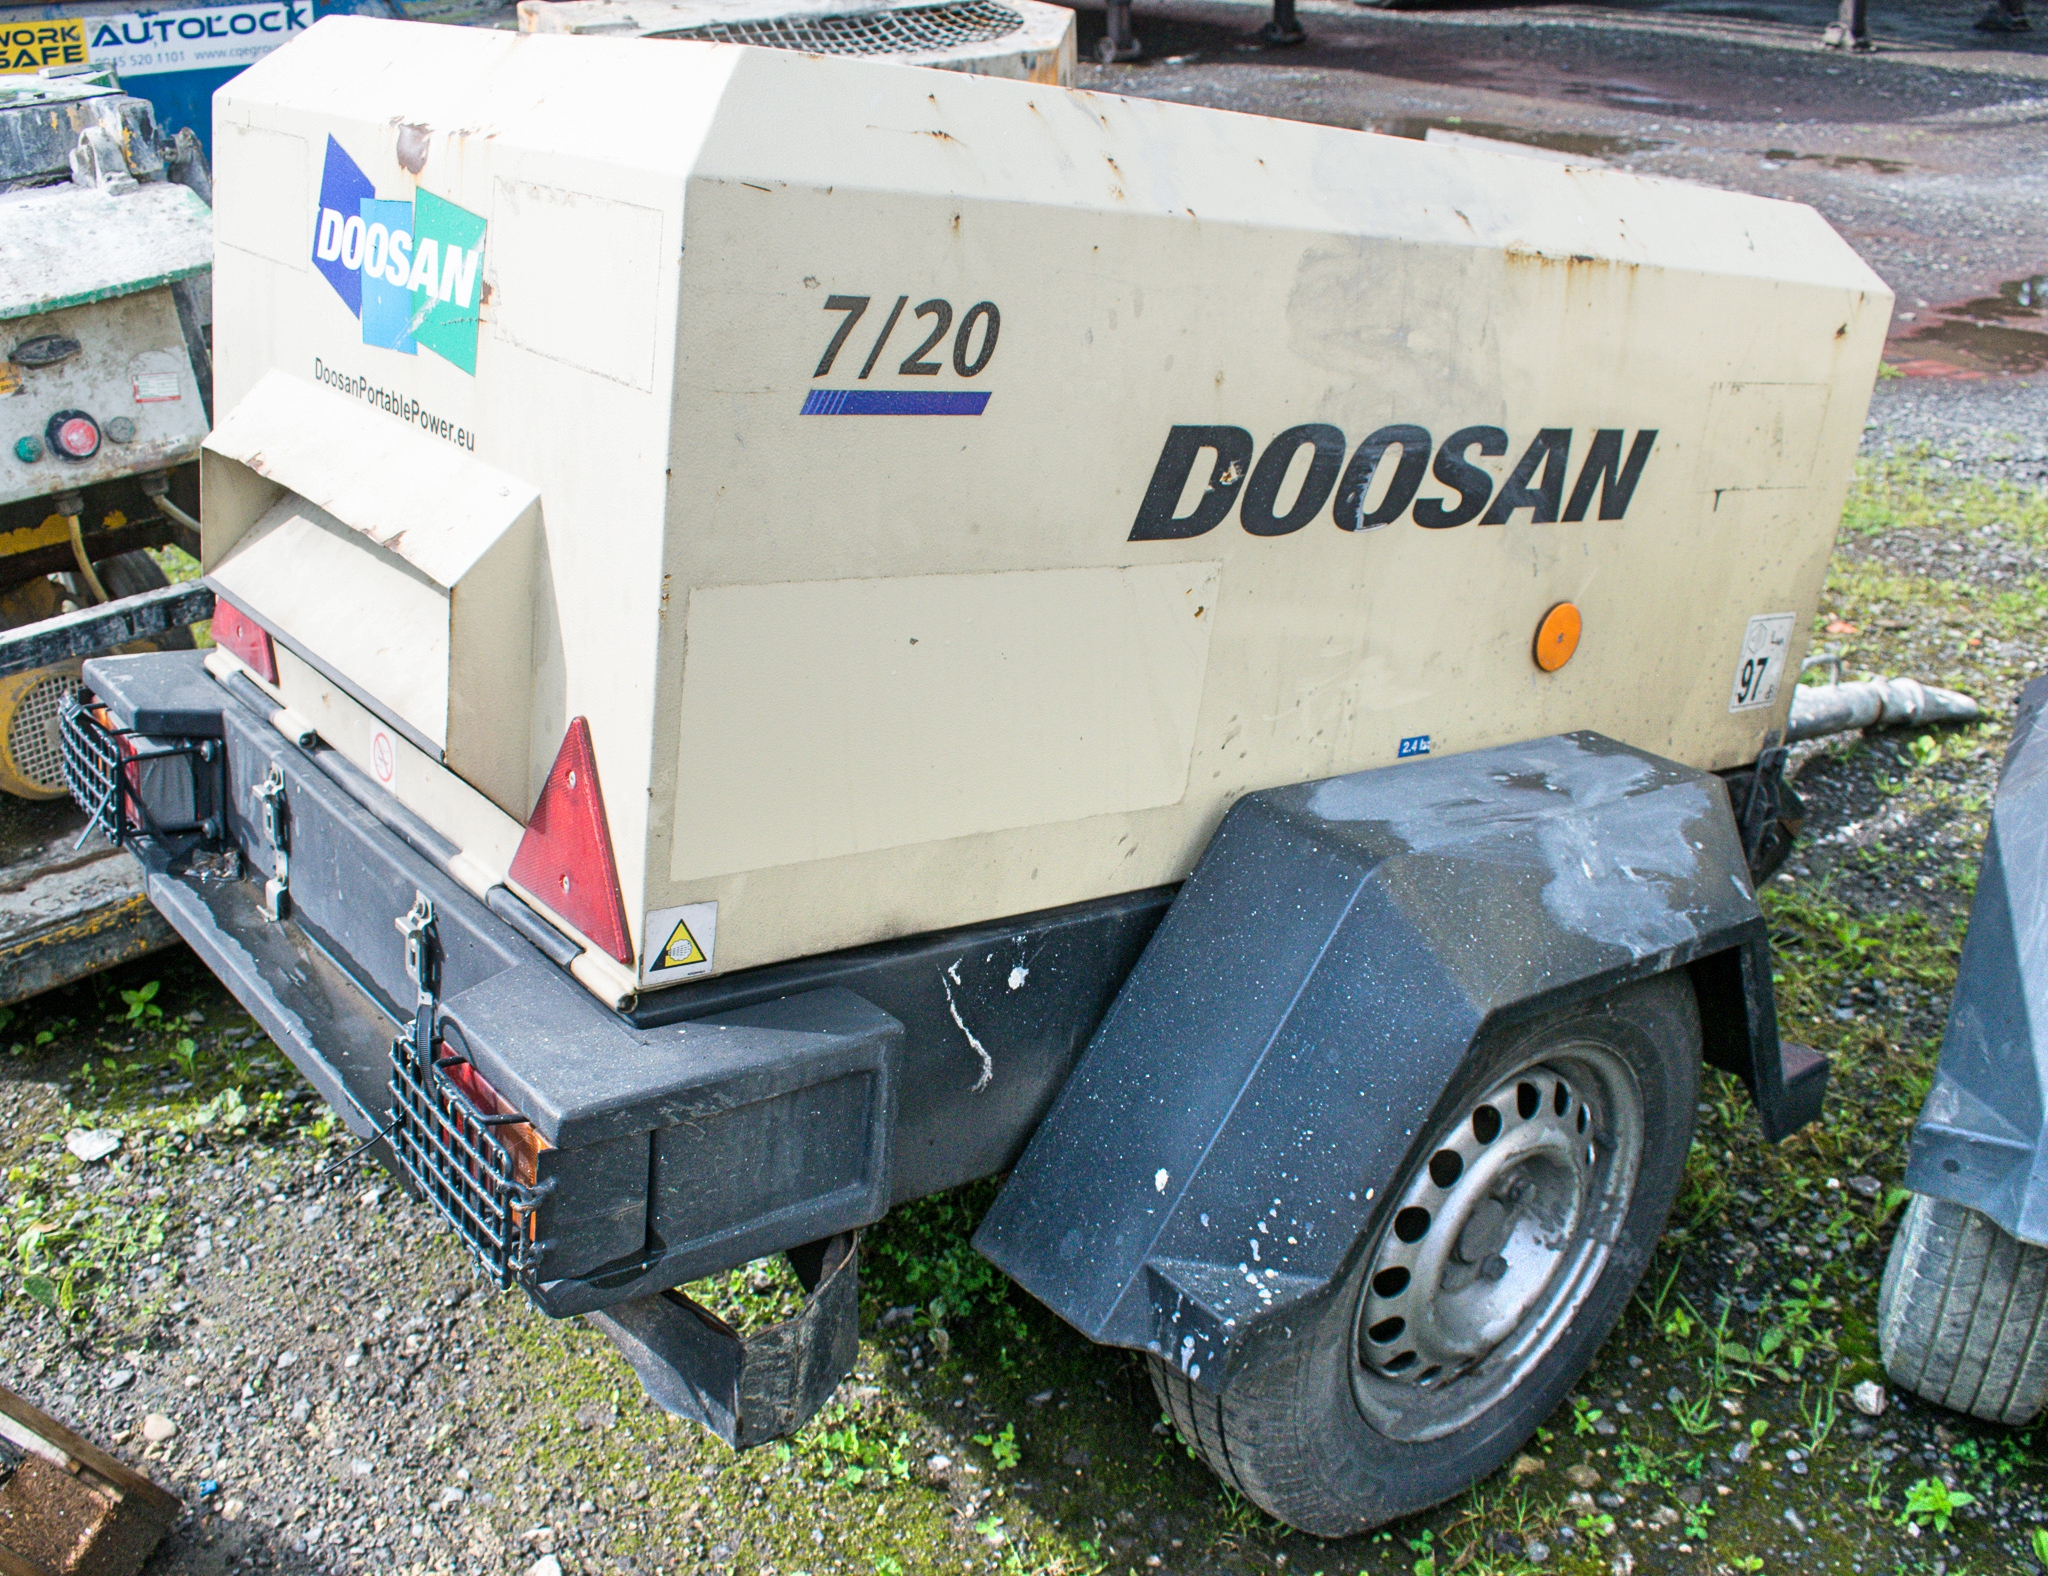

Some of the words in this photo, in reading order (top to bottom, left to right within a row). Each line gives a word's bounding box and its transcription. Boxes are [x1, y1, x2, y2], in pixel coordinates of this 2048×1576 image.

[91, 8, 307, 47] AUTOLOCK
[130, 53, 153, 66] 520
[157, 50, 185, 63] 1101
[317, 207, 480, 309] DOOSAN
[812, 294, 1001, 380] 7/20
[315, 357, 475, 452] DoosanPortablePower.eu
[1127, 423, 1659, 542] DOOSAN
[1736, 657, 1769, 703] 97
[1402, 739, 1418, 753] 2.4
